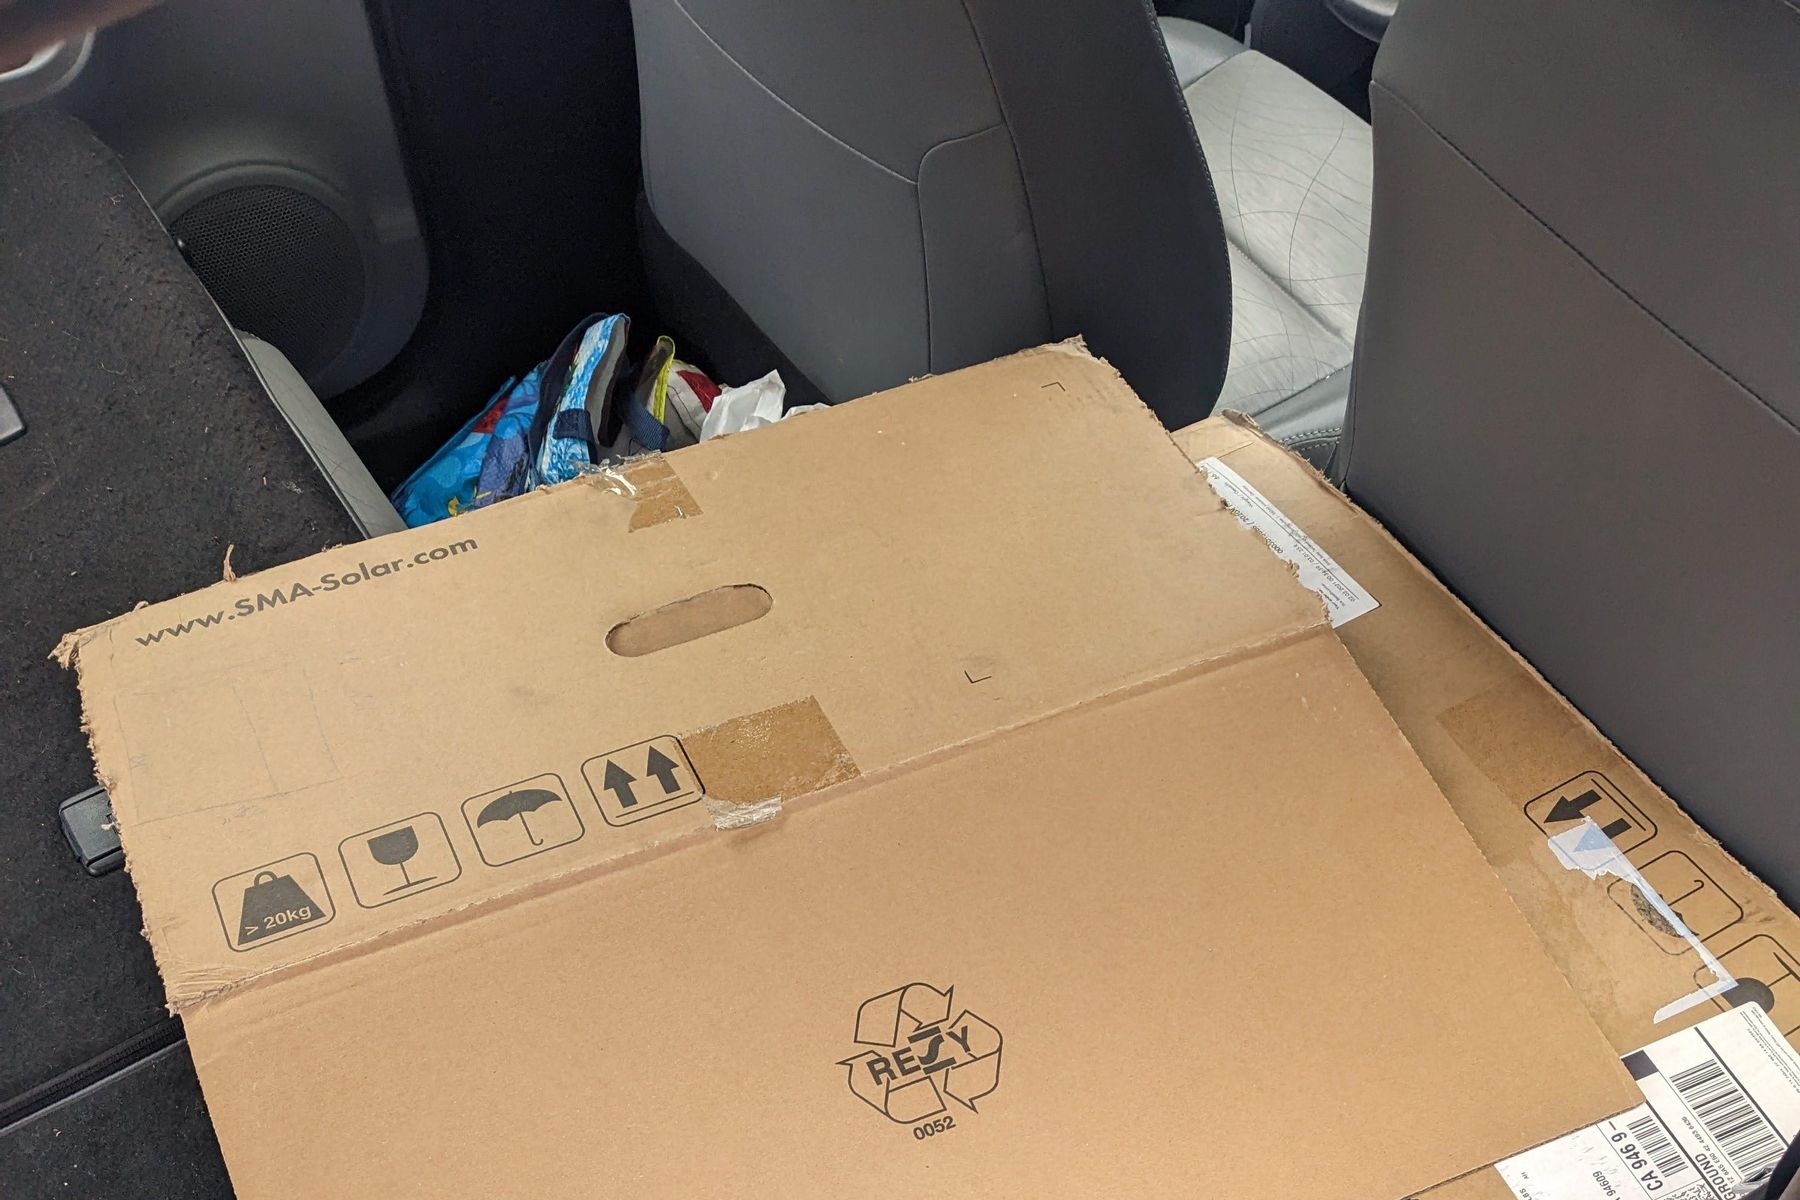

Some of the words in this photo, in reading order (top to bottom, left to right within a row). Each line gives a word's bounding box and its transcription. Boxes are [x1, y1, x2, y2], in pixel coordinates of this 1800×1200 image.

[135, 538, 478, 647] www.SMA-Solar.com
[263, 905, 312, 930] 20kg
[912, 1115, 957, 1141] 0052
[1620, 1144, 1647, 1170] 946
[1592, 1170, 1617, 1198] 94609
[1641, 1170, 1663, 1191] CA
[1695, 1153, 1736, 1200] GROUND
